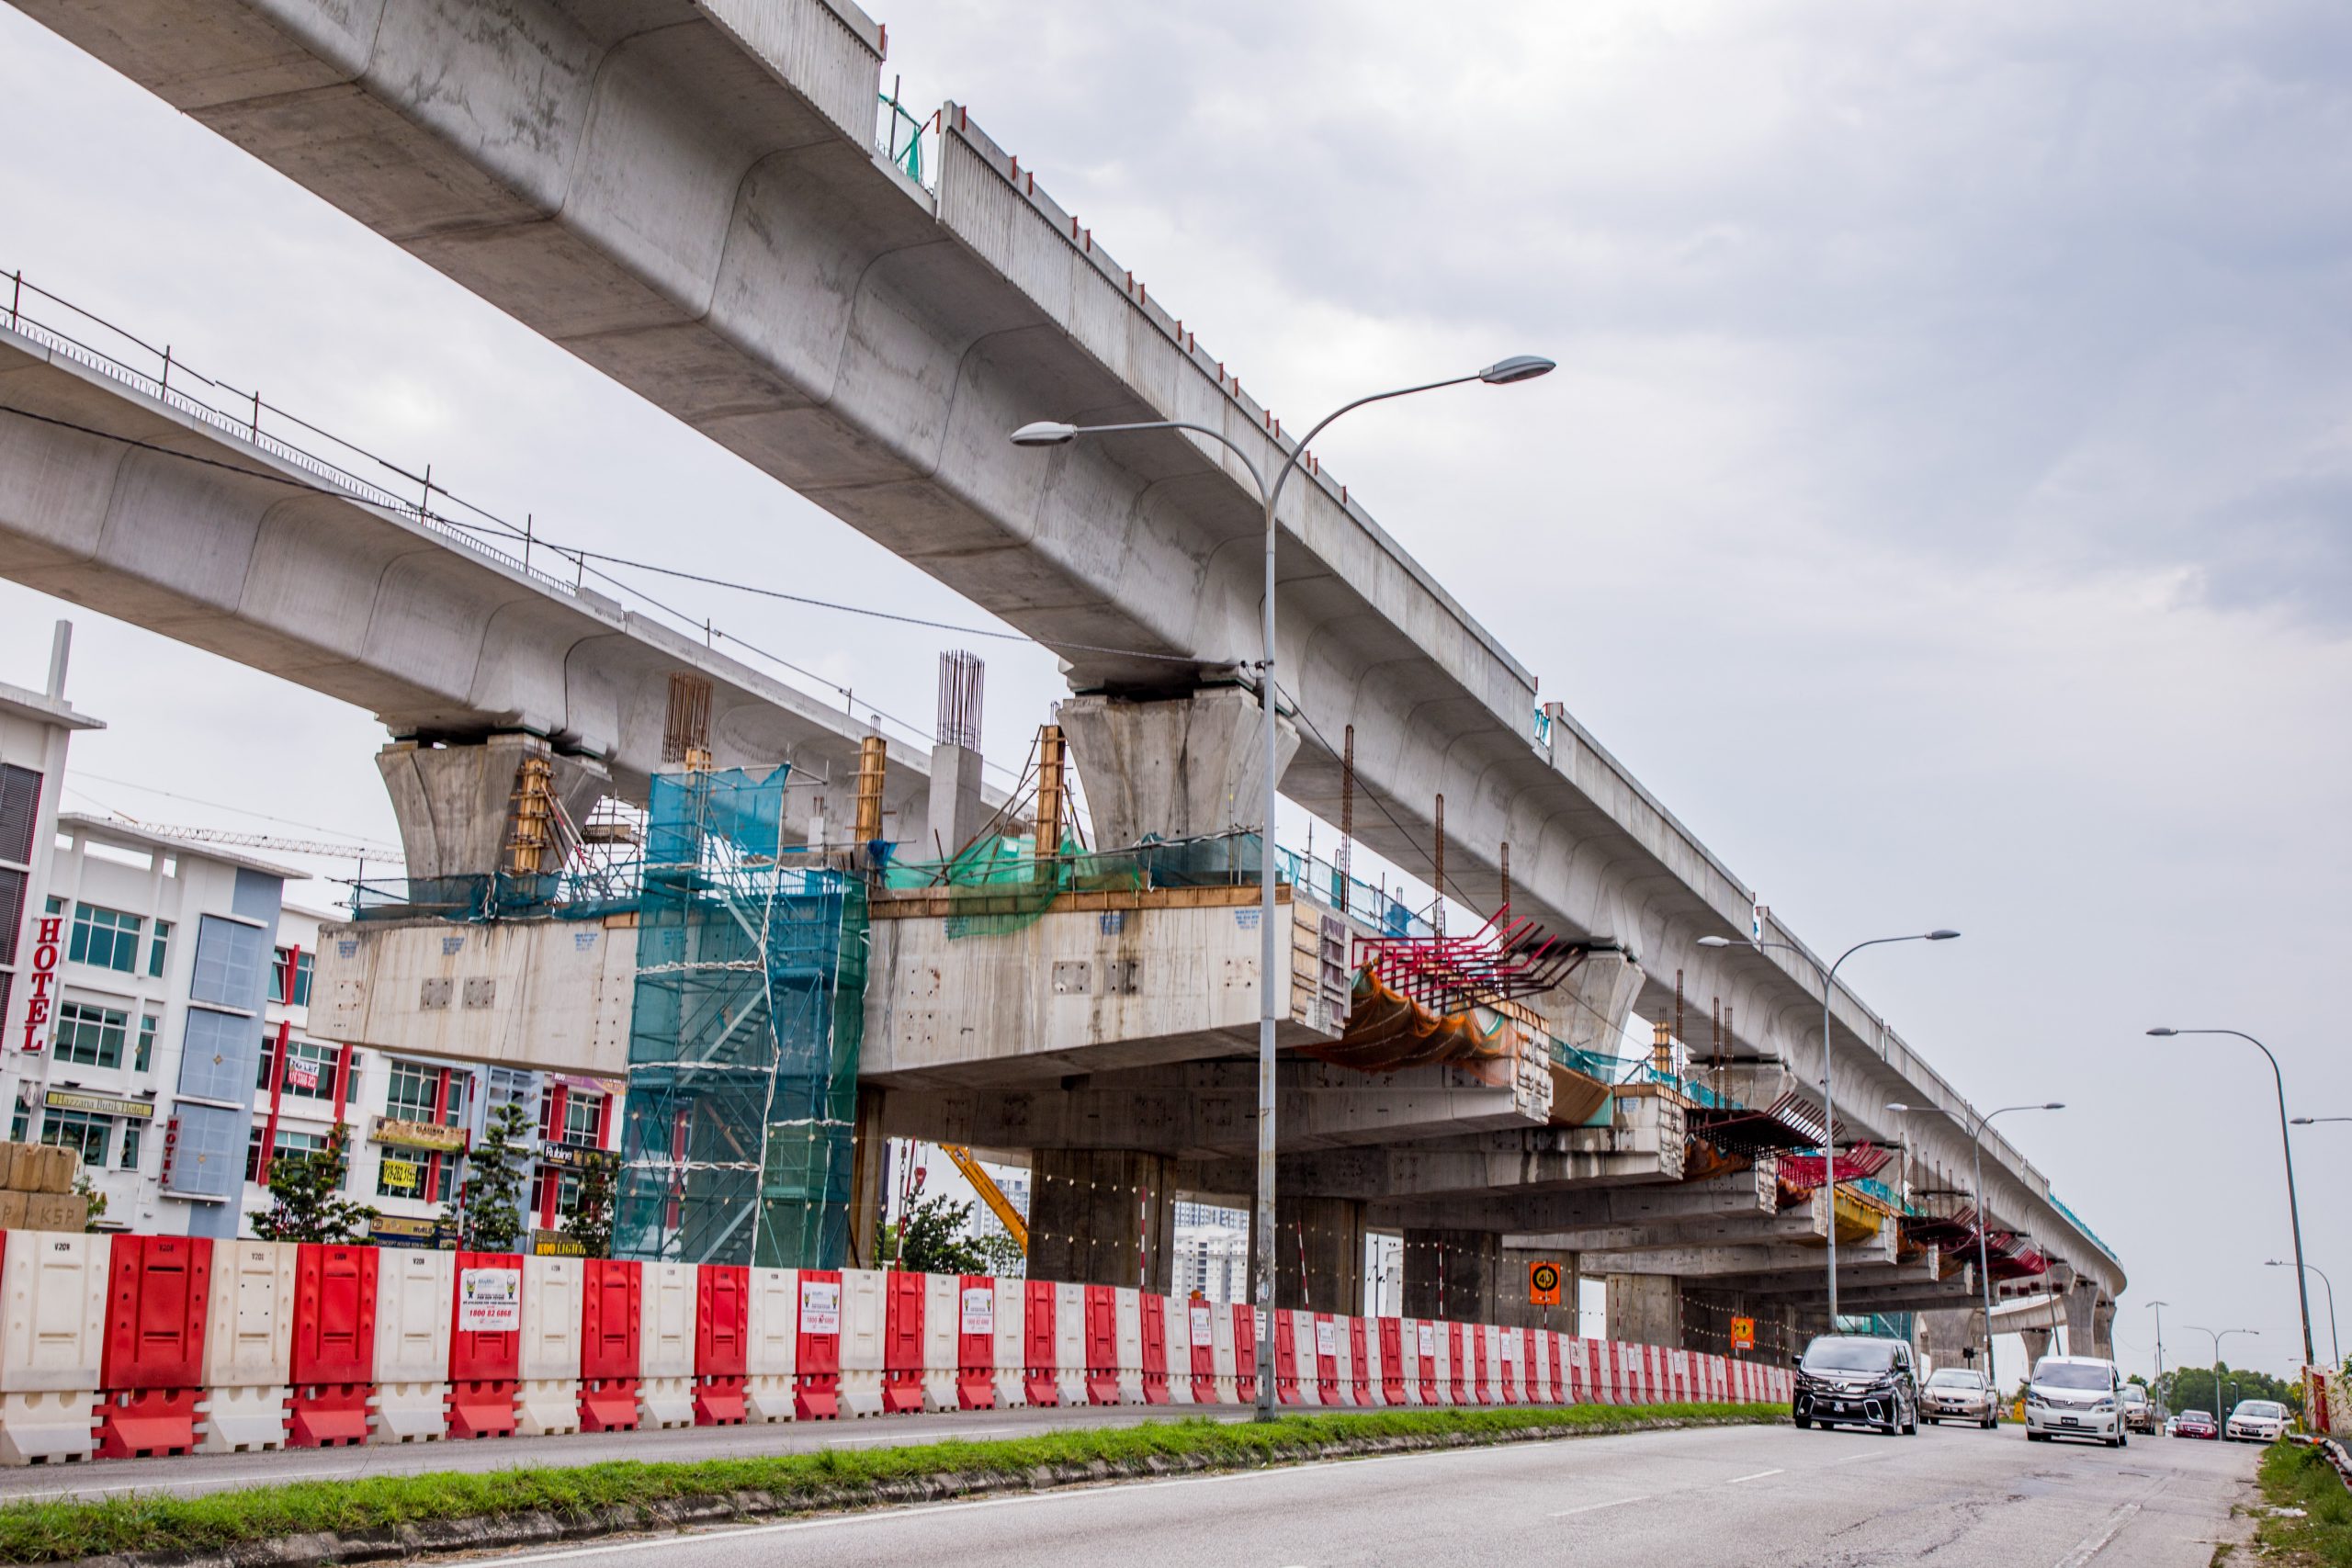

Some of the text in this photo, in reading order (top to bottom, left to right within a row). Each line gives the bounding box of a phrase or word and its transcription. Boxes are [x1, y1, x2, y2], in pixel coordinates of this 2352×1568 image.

[21, 918, 63, 1051] HOTEL
[303, 1063, 317, 1073] LET
[97, 1098, 119, 1111] Butik
[121, 1101, 145, 1115] Hotel
[161, 1119, 178, 1184] HOTEL
[40, 1206, 74, 1225] KSP
[413, 1226, 433, 1235] WORLD
[536, 1242, 556, 1256] KOO
[1538, 1273, 1552, 1285] 40
[469, 1309, 485, 1317] 1800
